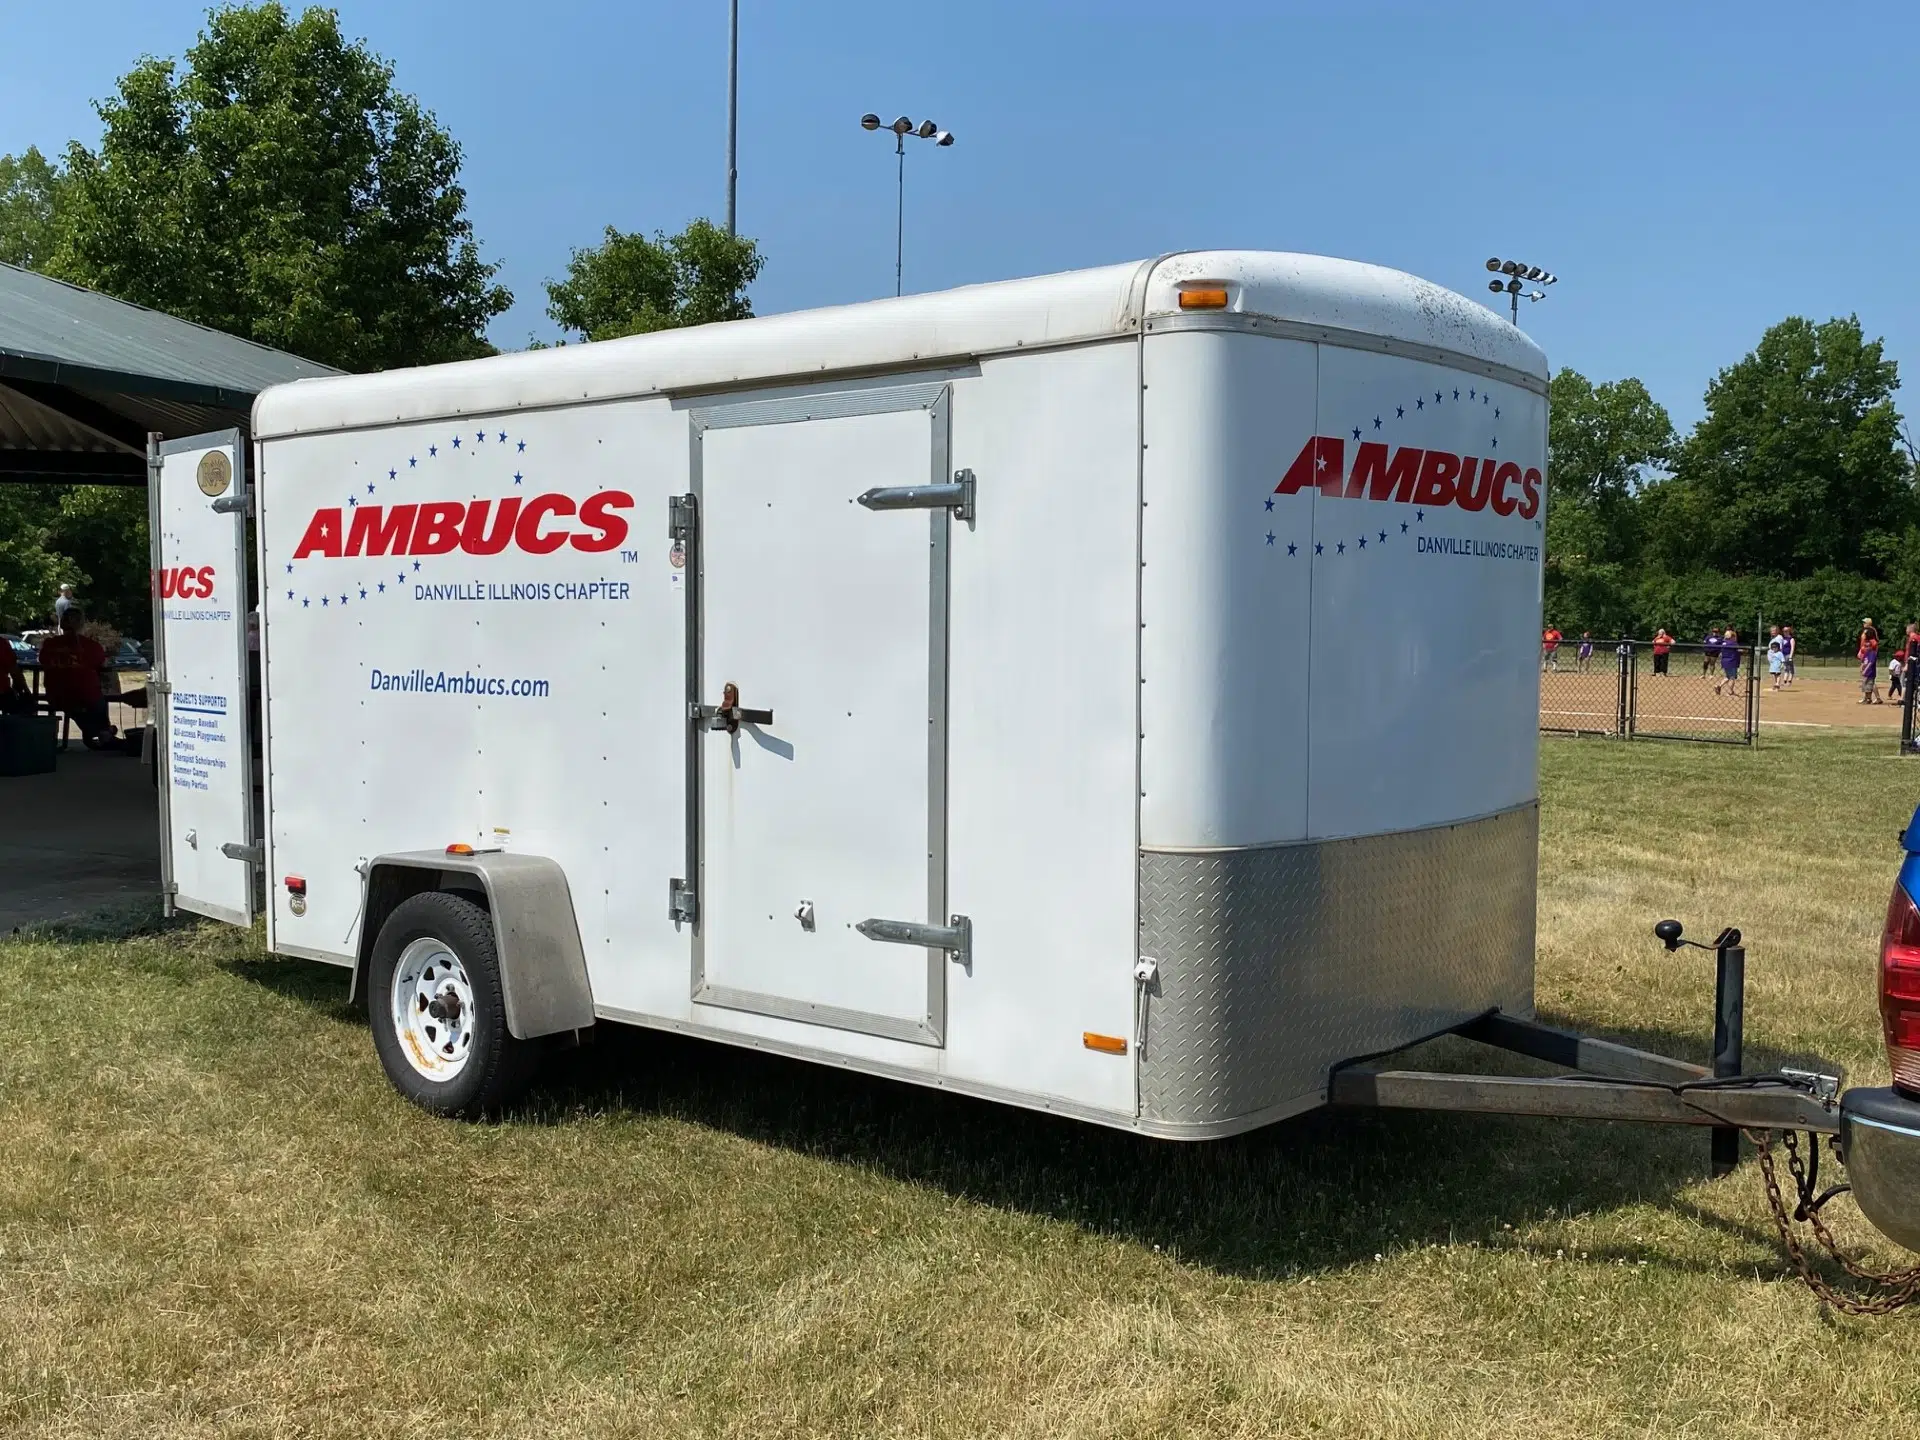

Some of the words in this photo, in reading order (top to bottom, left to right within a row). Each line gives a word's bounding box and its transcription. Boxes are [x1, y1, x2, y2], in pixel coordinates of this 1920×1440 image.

[1273, 436, 1542, 520] AMBUCS
[293, 490, 635, 559] AMBUCS
[1417, 536, 1471, 555] DANVILLE
[1472, 540, 1506, 558] ILLINOIS
[150, 566, 215, 599] UCS
[415, 584, 485, 601] DANVILLE
[488, 583, 551, 600] ILLINOIS
[553, 582, 630, 600] CHAPTER
[370, 669, 549, 697] DanvilleAmbucs.com
[173, 692, 197, 705] PROJECTS
[198, 694, 227, 708] SUPPORTED
